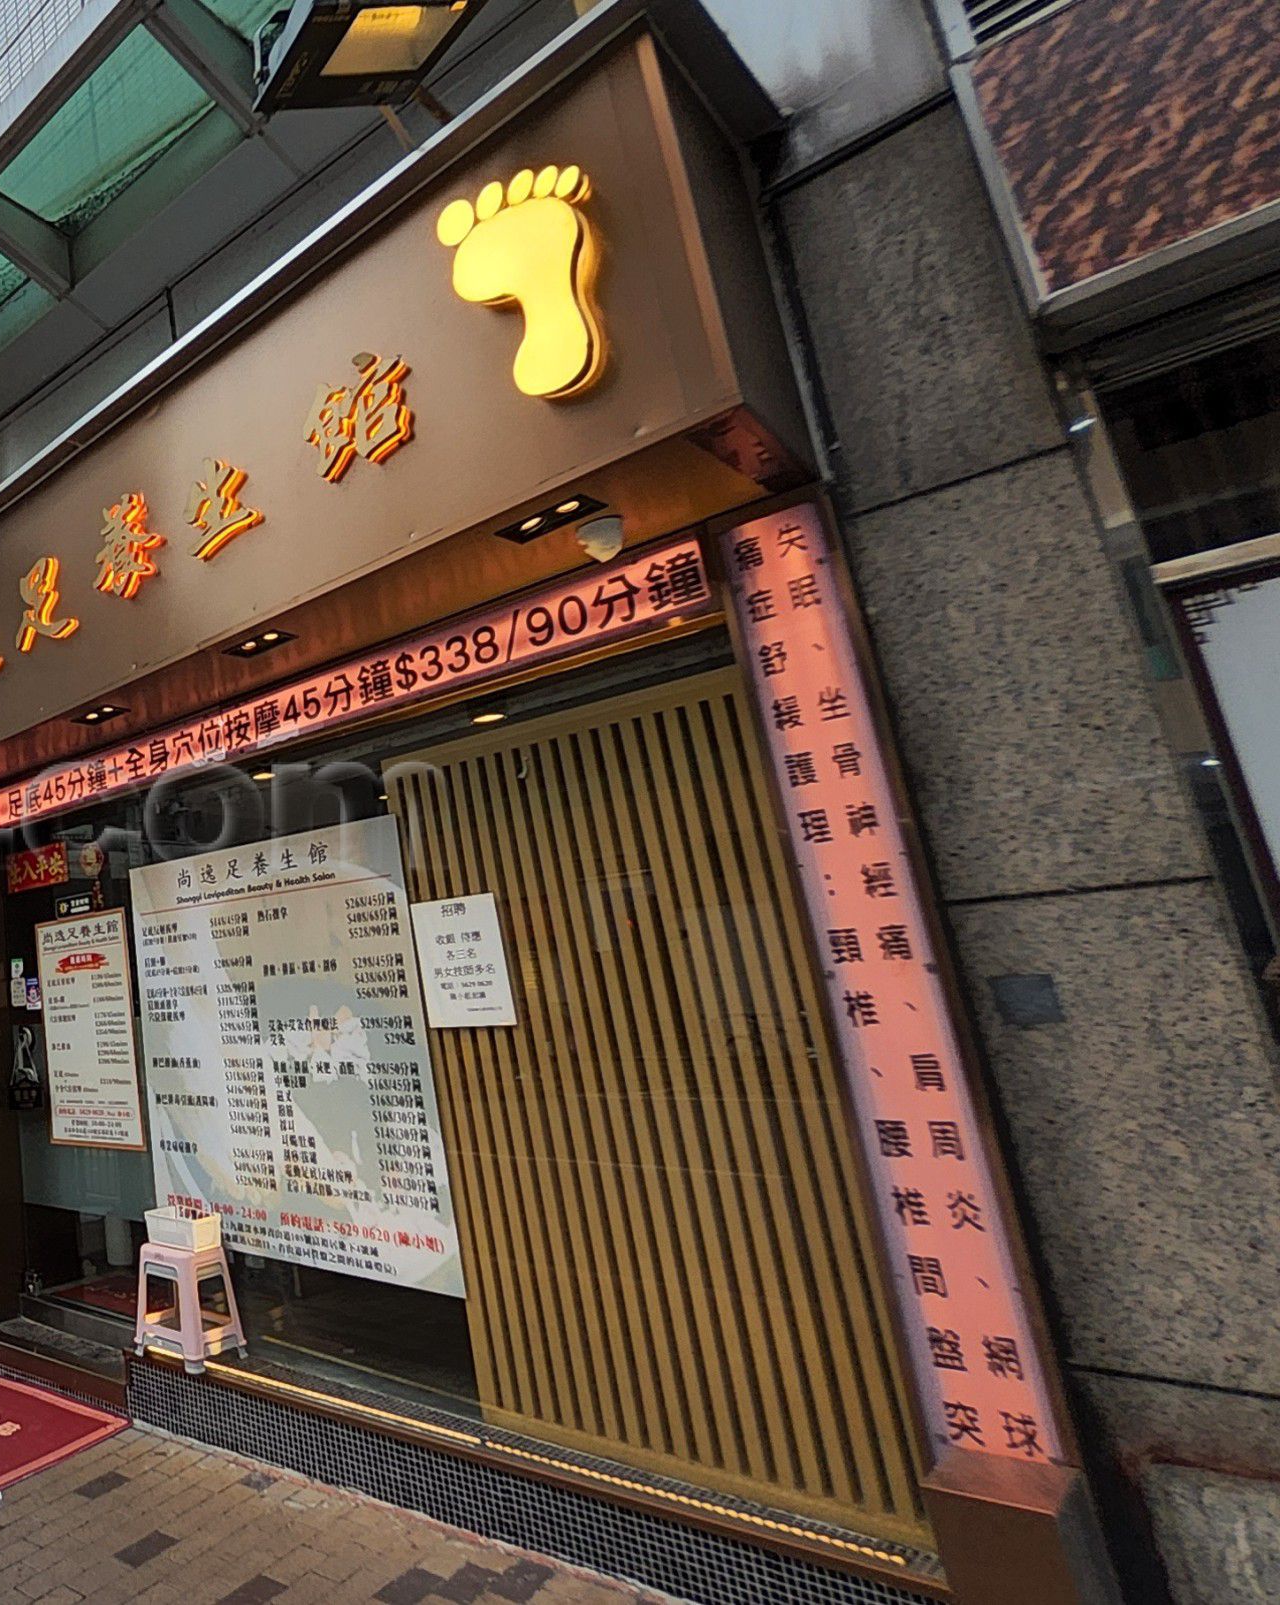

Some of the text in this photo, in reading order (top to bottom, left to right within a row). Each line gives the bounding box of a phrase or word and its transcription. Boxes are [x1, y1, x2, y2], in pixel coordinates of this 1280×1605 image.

[177, 841, 329, 889] 尚逸足養生館
[247, 881, 274, 894] Beauty
[276, 879, 282, 888] &
[284, 874, 311, 887] Health
[440, 902, 466, 918] 招聘
[332, 1221, 359, 1238] 5629
[361, 1225, 390, 1243] 0620
